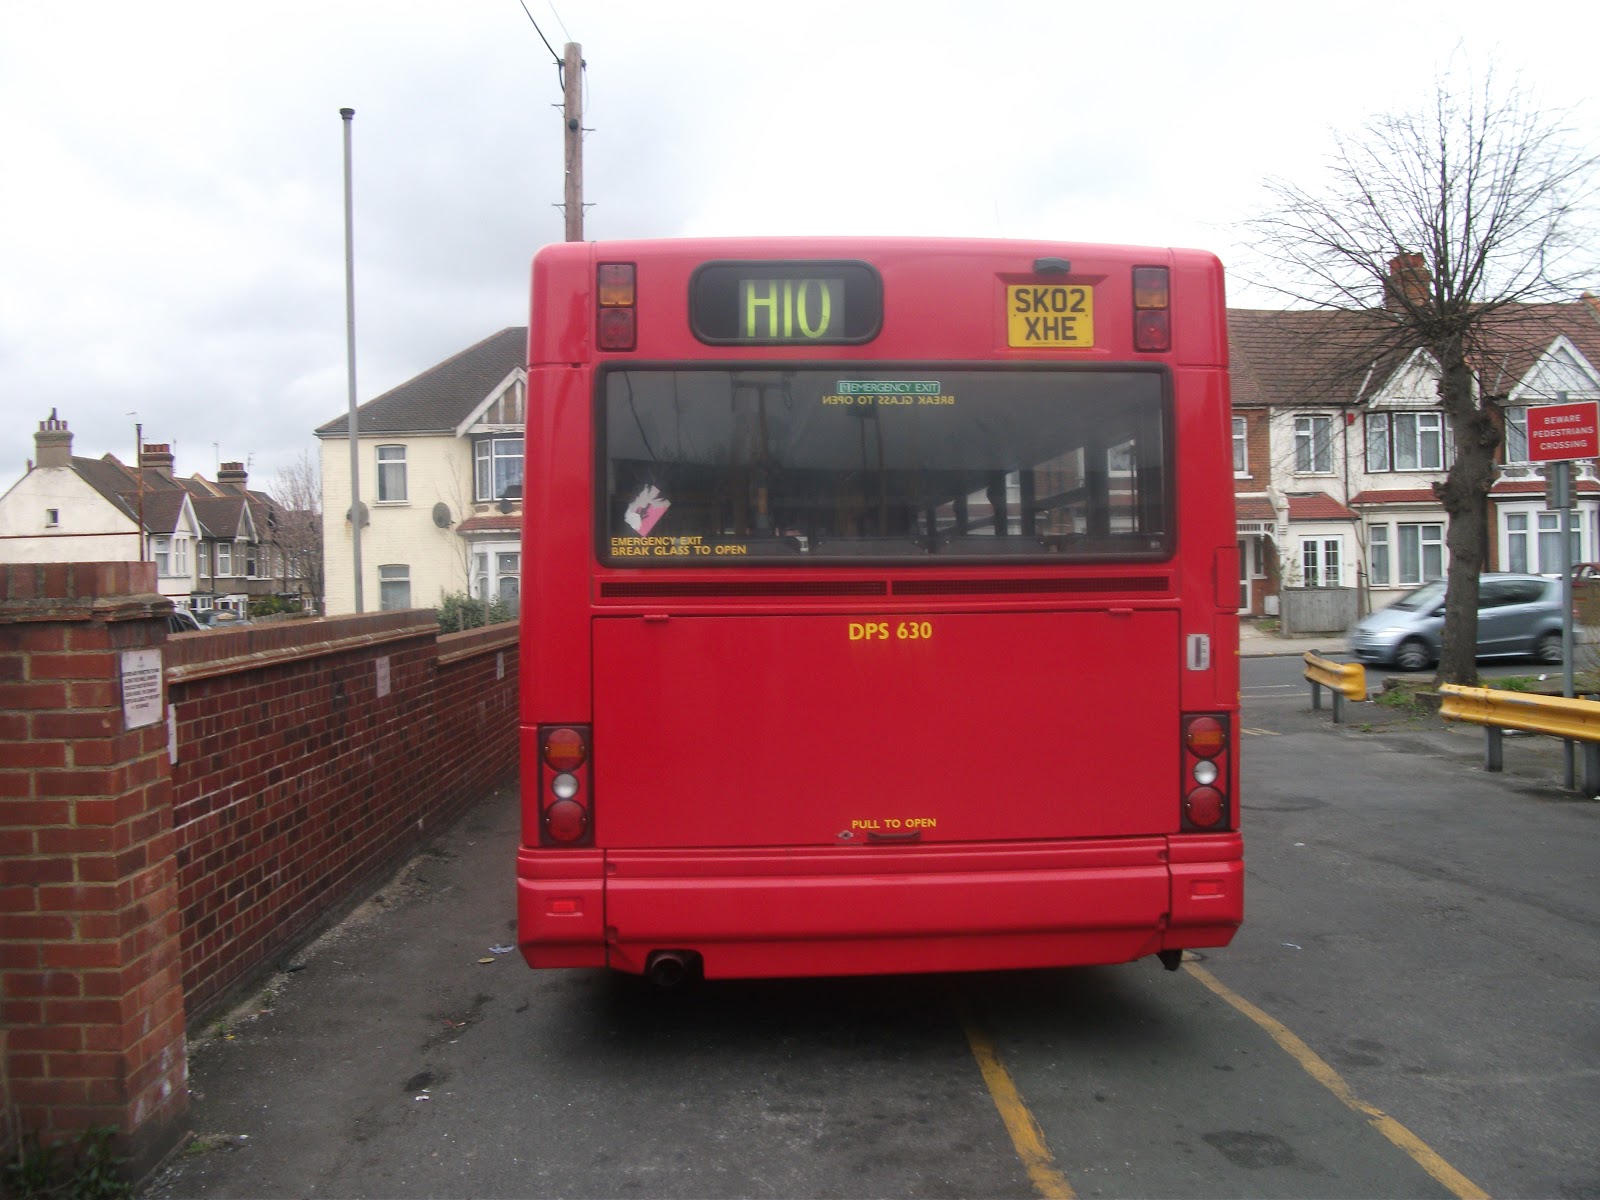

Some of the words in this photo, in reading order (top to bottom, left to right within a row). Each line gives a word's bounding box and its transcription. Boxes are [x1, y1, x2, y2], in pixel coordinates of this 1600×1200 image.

[1014, 288, 1086, 313] SK02
[746, 279, 832, 339] H10
[1025, 316, 1077, 341] XHE
[851, 383, 911, 393] EMERGENCY
[915, 383, 937, 393] EXIT
[1543, 414, 1582, 425] BEWARE
[1532, 426, 1594, 438] PEDESTRIANS
[1540, 439, 1588, 450] CROSSING
[611, 537, 676, 546] EMERGENCY
[680, 536, 703, 545] EXIT
[611, 546, 650, 556] BREAK
[653, 546, 690, 556] GLASS
[693, 545, 711, 555] TO
[715, 545, 747, 555] OPEN
[848, 622, 890, 640] DPS
[896, 621, 933, 639] 630
[852, 819, 881, 829] PULL
[884, 819, 901, 828] TO
[905, 818, 937, 828] OPEN
